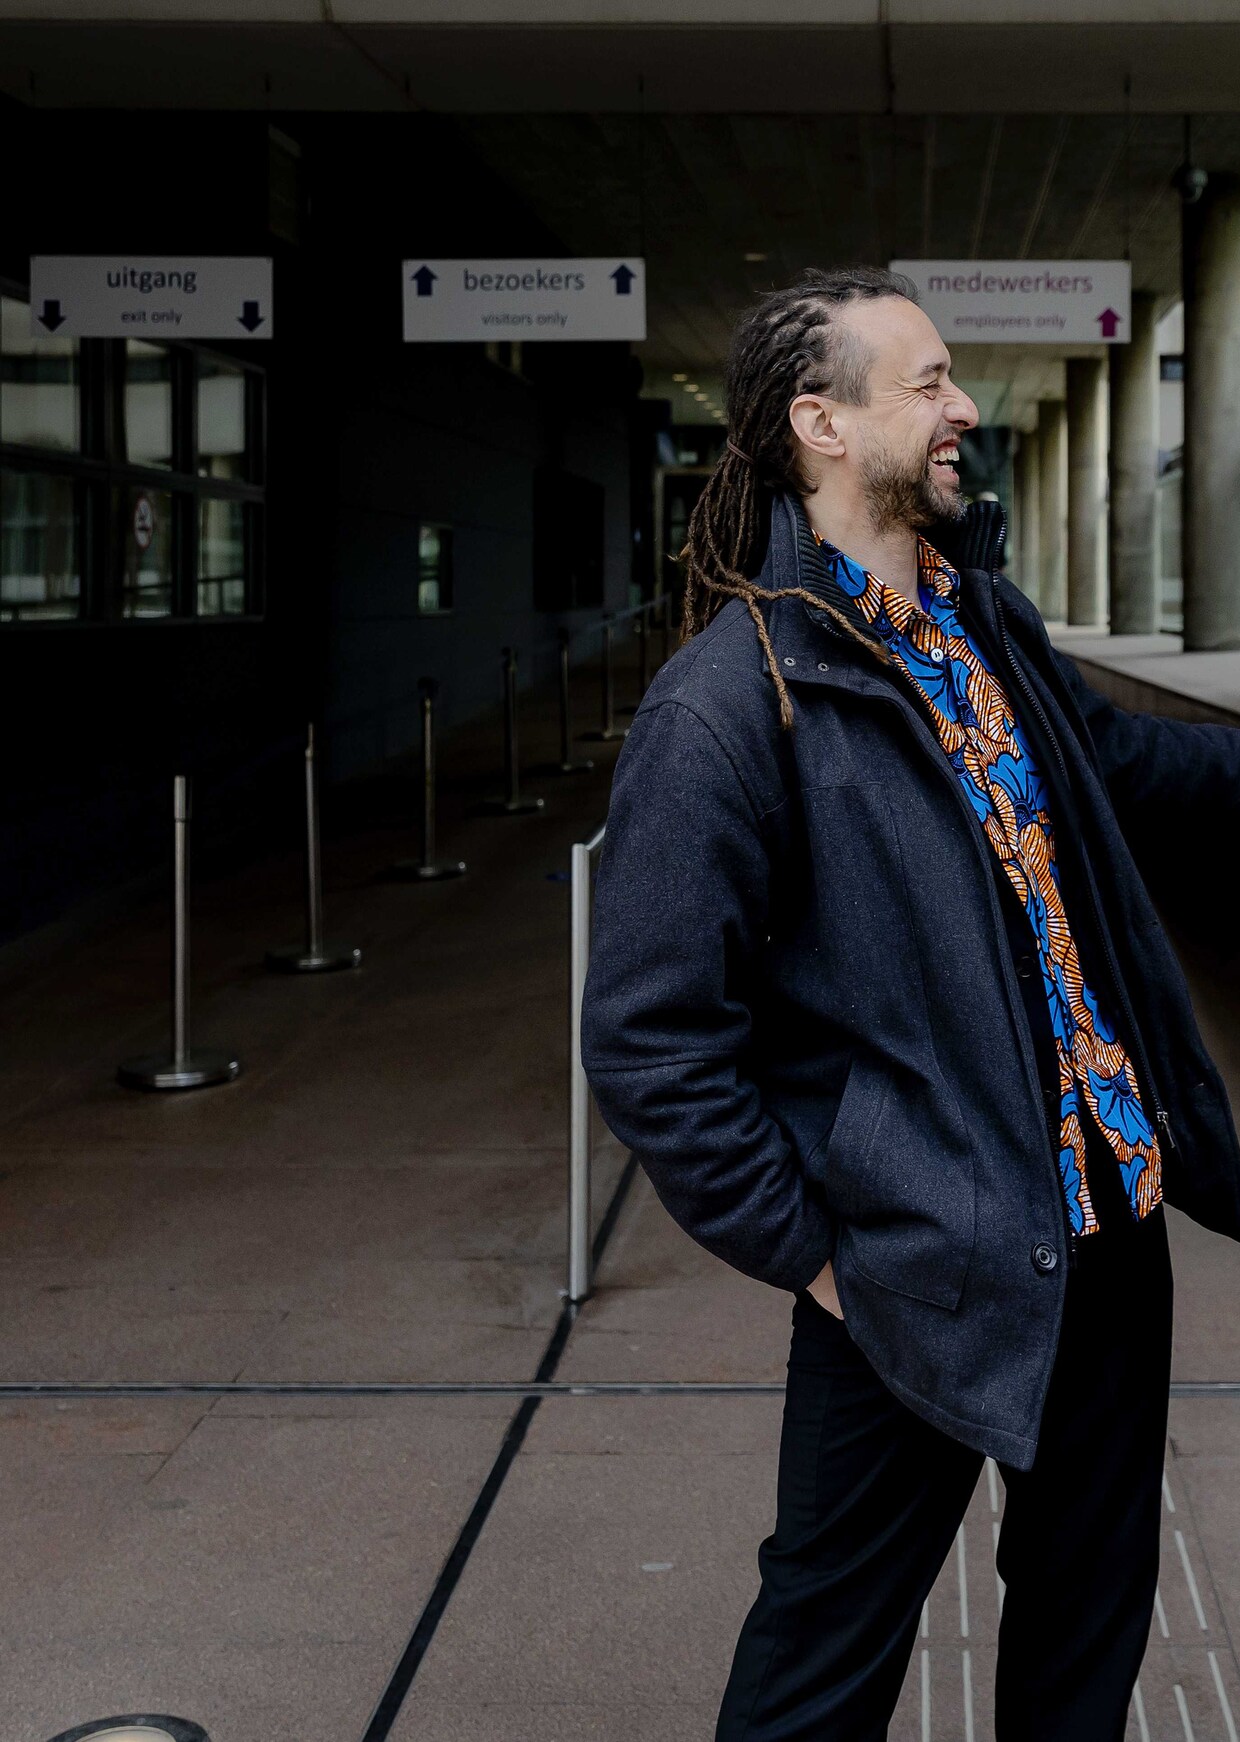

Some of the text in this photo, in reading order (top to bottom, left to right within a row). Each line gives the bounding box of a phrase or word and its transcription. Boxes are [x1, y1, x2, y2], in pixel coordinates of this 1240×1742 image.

[106, 267, 197, 294] uitgang
[464, 269, 585, 292] bezoekers
[928, 271, 1093, 294] medewerkers
[121, 309, 182, 326] exit only
[481, 311, 568, 329] visitors only
[953, 312, 1067, 331] employees only
